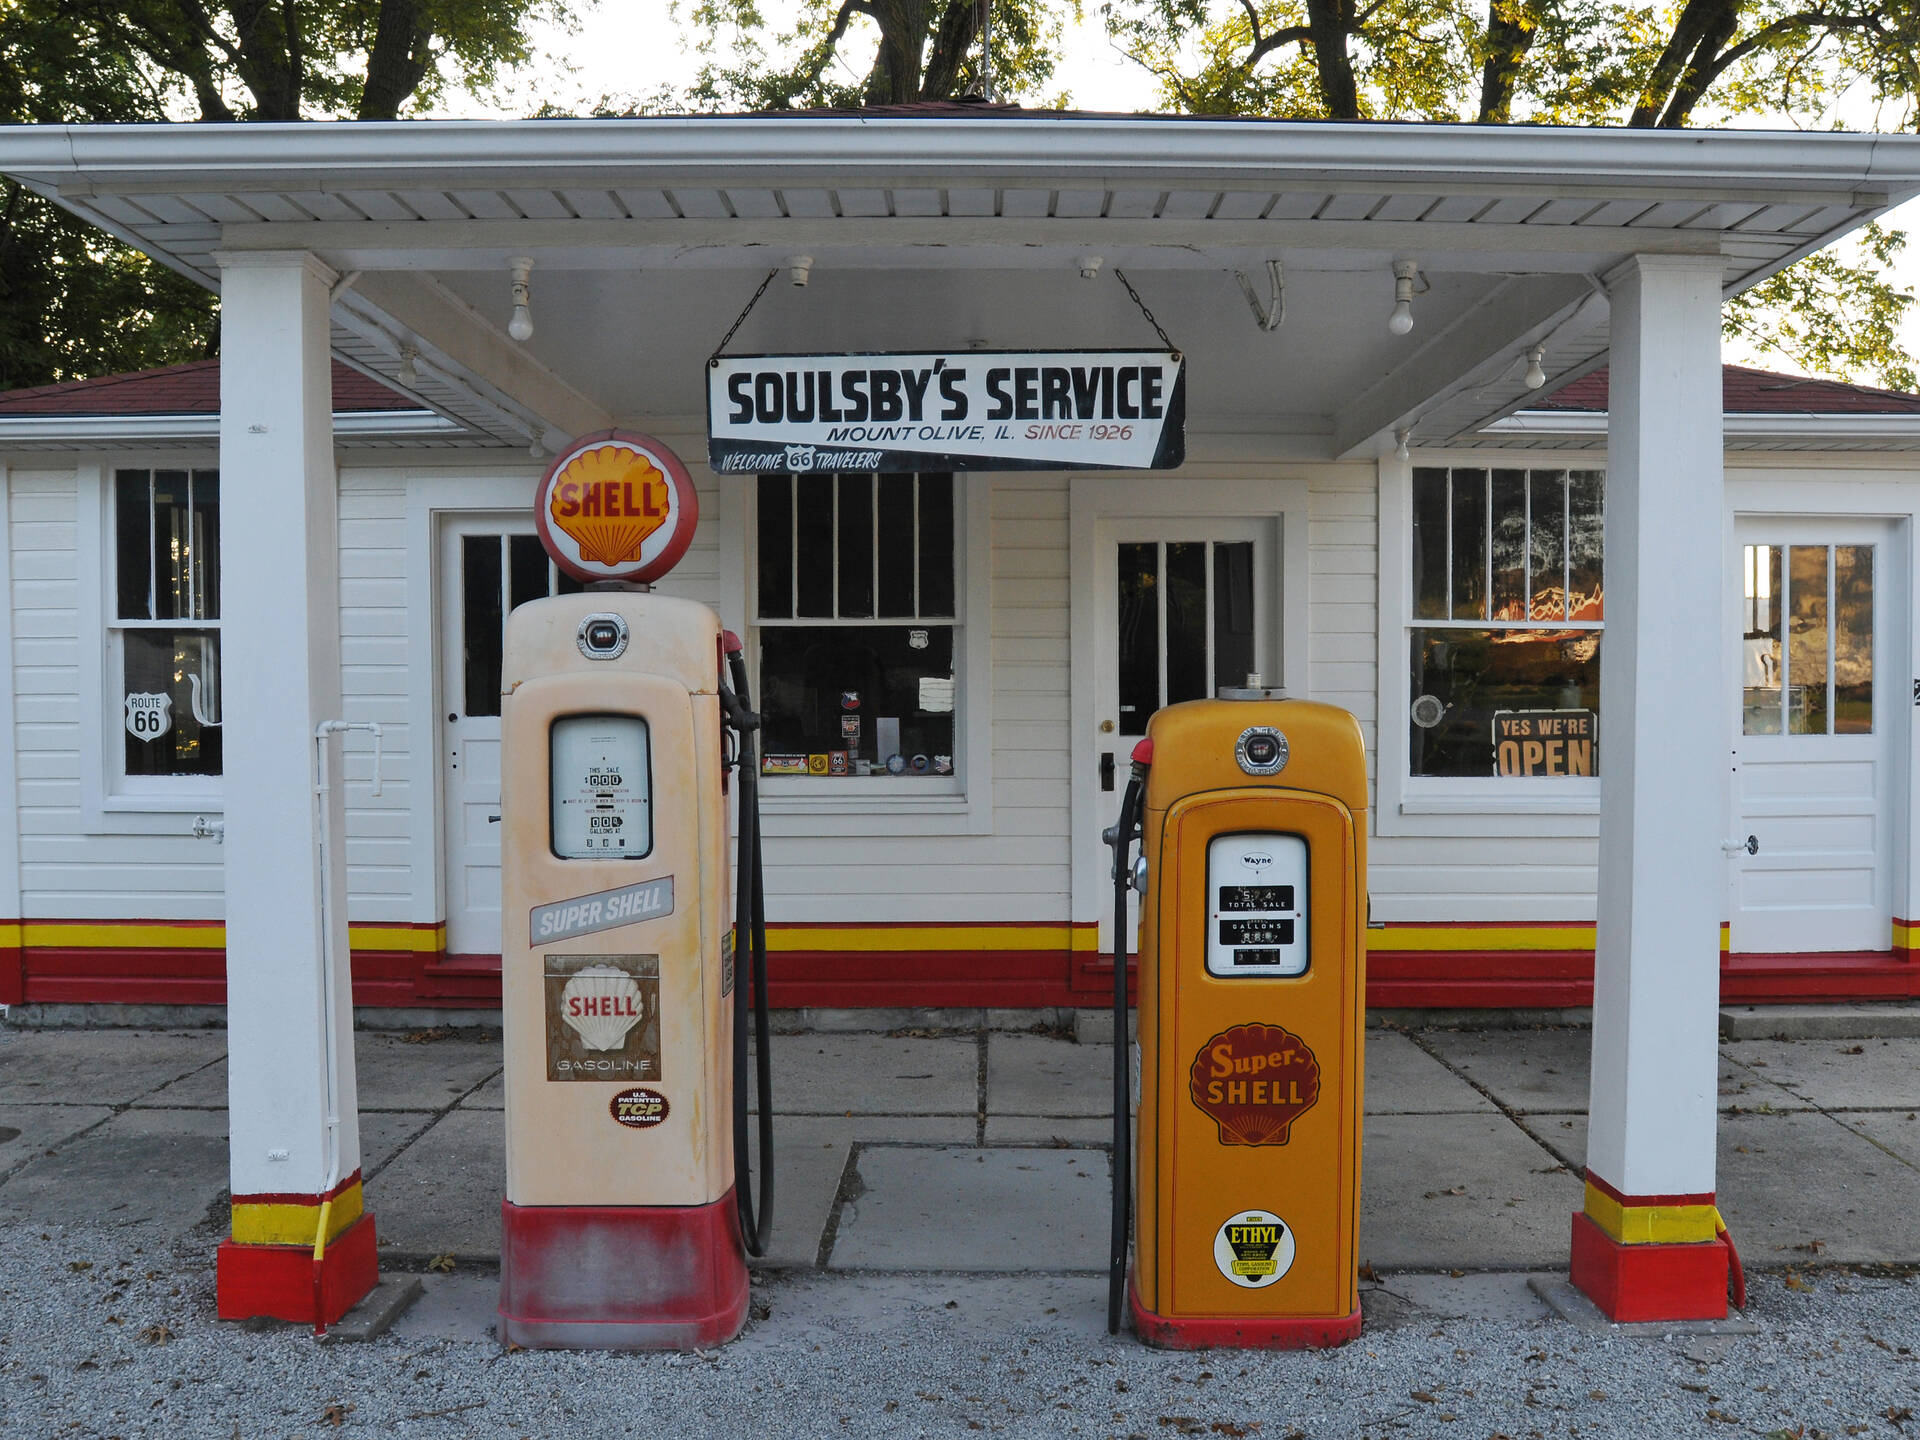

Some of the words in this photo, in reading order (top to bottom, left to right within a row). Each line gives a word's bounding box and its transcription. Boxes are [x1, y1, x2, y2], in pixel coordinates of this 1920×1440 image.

[728, 358, 968, 424] SOULSBY'S
[986, 366, 1163, 420] SERVICE
[826, 426, 916, 442] MOUNT
[918, 425, 985, 444] OLIVE,
[994, 425, 1015, 440] IL.
[1024, 424, 1083, 440] SINCE
[1088, 424, 1134, 441] 1926
[721, 451, 785, 471] WELCOME
[789, 454, 811, 467] 66
[815, 450, 883, 469] TRAVELERS
[559, 482, 660, 517] SHELL
[131, 697, 161, 708] ROUTE
[134, 710, 160, 732] 66
[1501, 719, 1531, 736] YES
[1538, 718, 1588, 735] WE'RE
[1499, 740, 1591, 777] OPEN
[1244, 857, 1272, 865] Wayne
[539, 901, 603, 936] SUPER
[606, 887, 662, 921] SHELL
[569, 996, 637, 1017] SHELL
[556, 1060, 652, 1071] GASOLINE
[1207, 1080, 1304, 1105] SHELL
[618, 1103, 663, 1115] TCP
[1231, 1227, 1280, 1244] ETHYL
